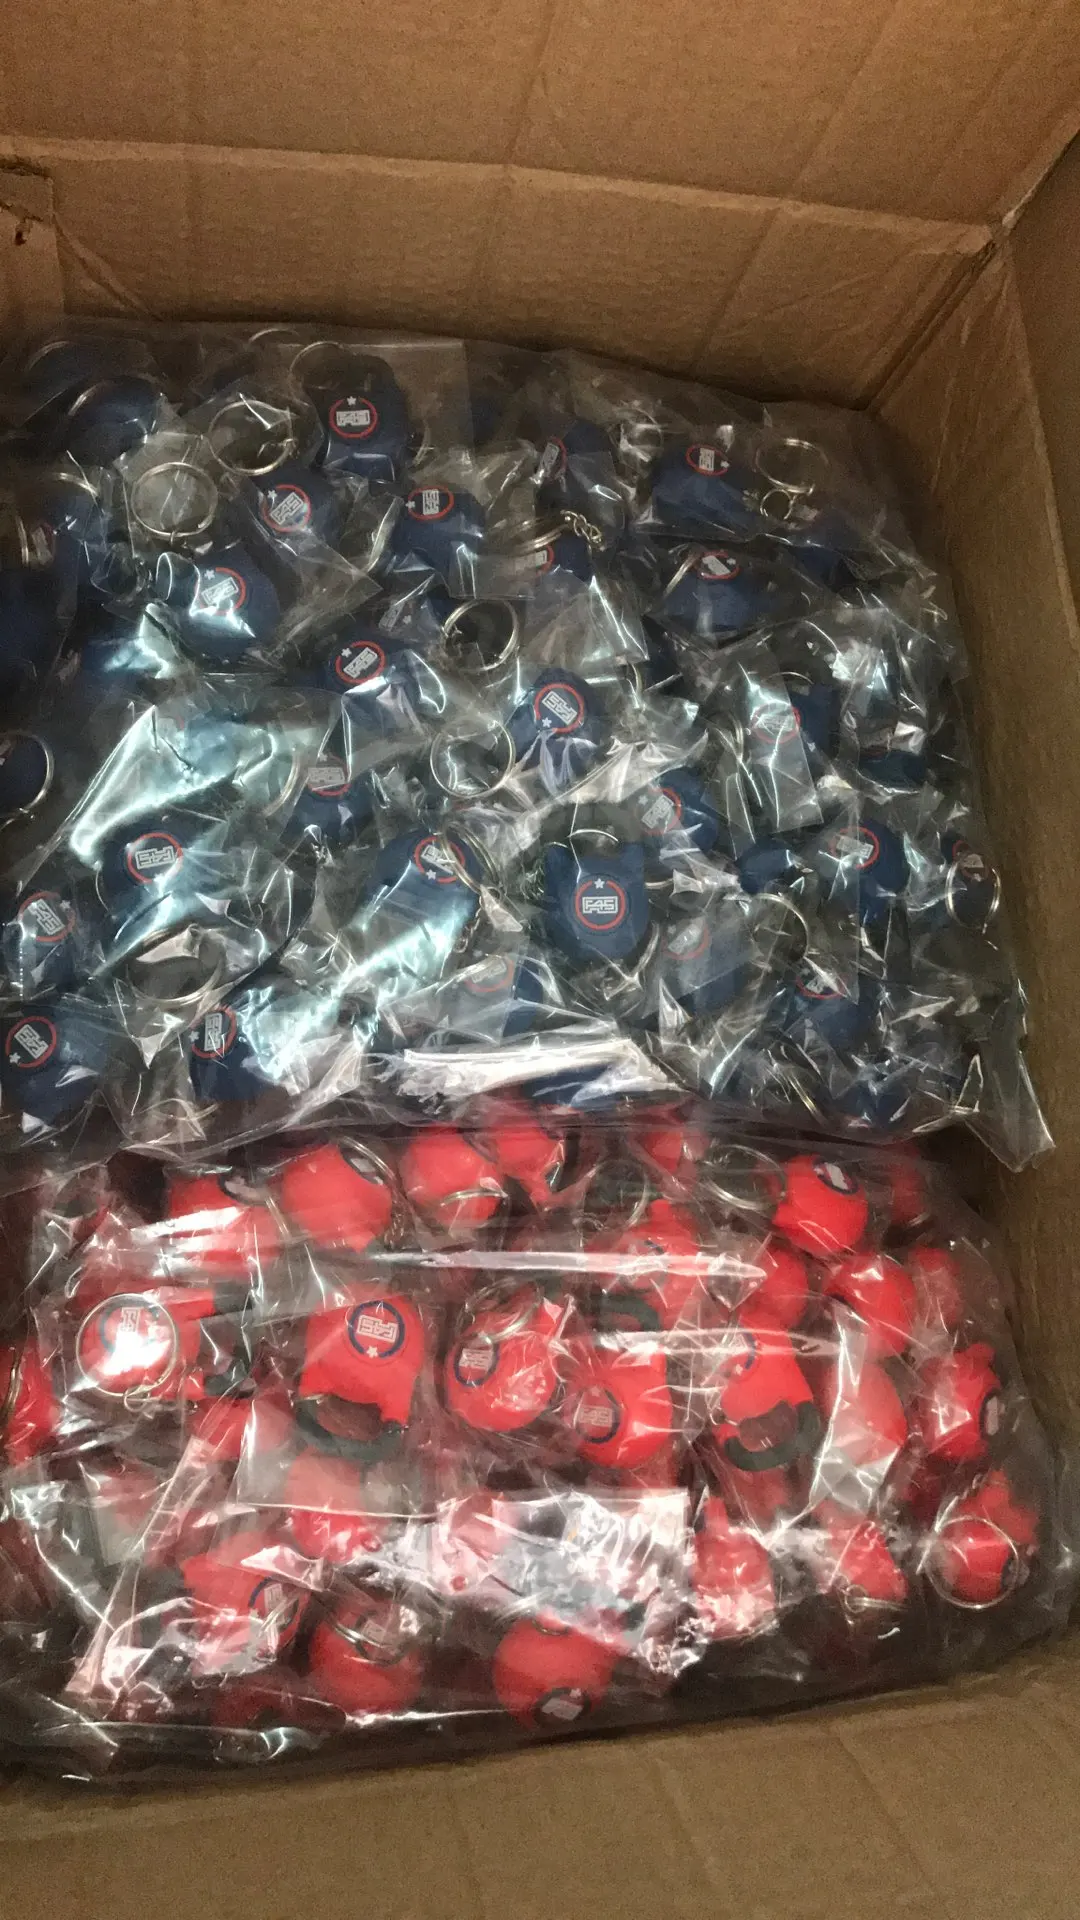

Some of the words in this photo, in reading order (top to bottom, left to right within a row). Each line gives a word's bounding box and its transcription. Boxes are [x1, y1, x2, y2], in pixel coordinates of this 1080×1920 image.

[270, 492, 304, 525] F45
[542, 690, 577, 725] F45
[135, 845, 174, 870] F45
[27, 899, 65, 936] F45
[582, 896, 618, 914] F45
[14, 1024, 48, 1059] F45
[204, 1013, 222, 1051] F45
[357, 1314, 400, 1343] F45
